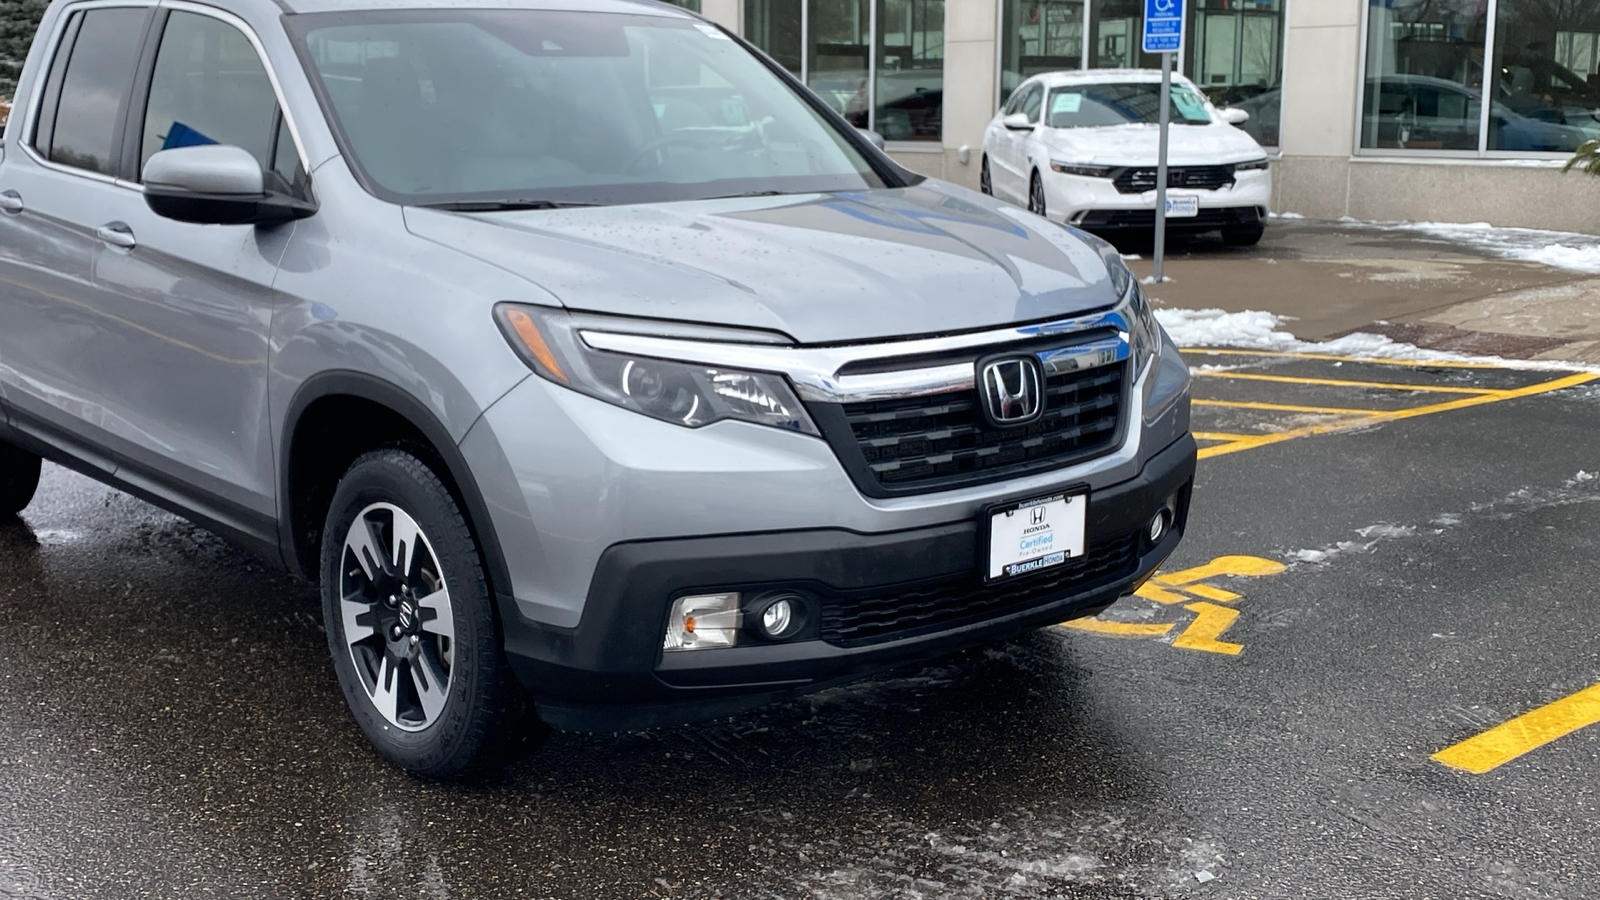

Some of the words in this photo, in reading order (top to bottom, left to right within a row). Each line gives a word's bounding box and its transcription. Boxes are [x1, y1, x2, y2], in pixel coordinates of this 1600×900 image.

[1023, 523, 1050, 535] HONDA
[1020, 532, 1053, 550] Certified
[1019, 544, 1053, 557] Pre-Owned
[1010, 558, 1043, 575] BUERKLE
[1043, 554, 1064, 567] HONDA
